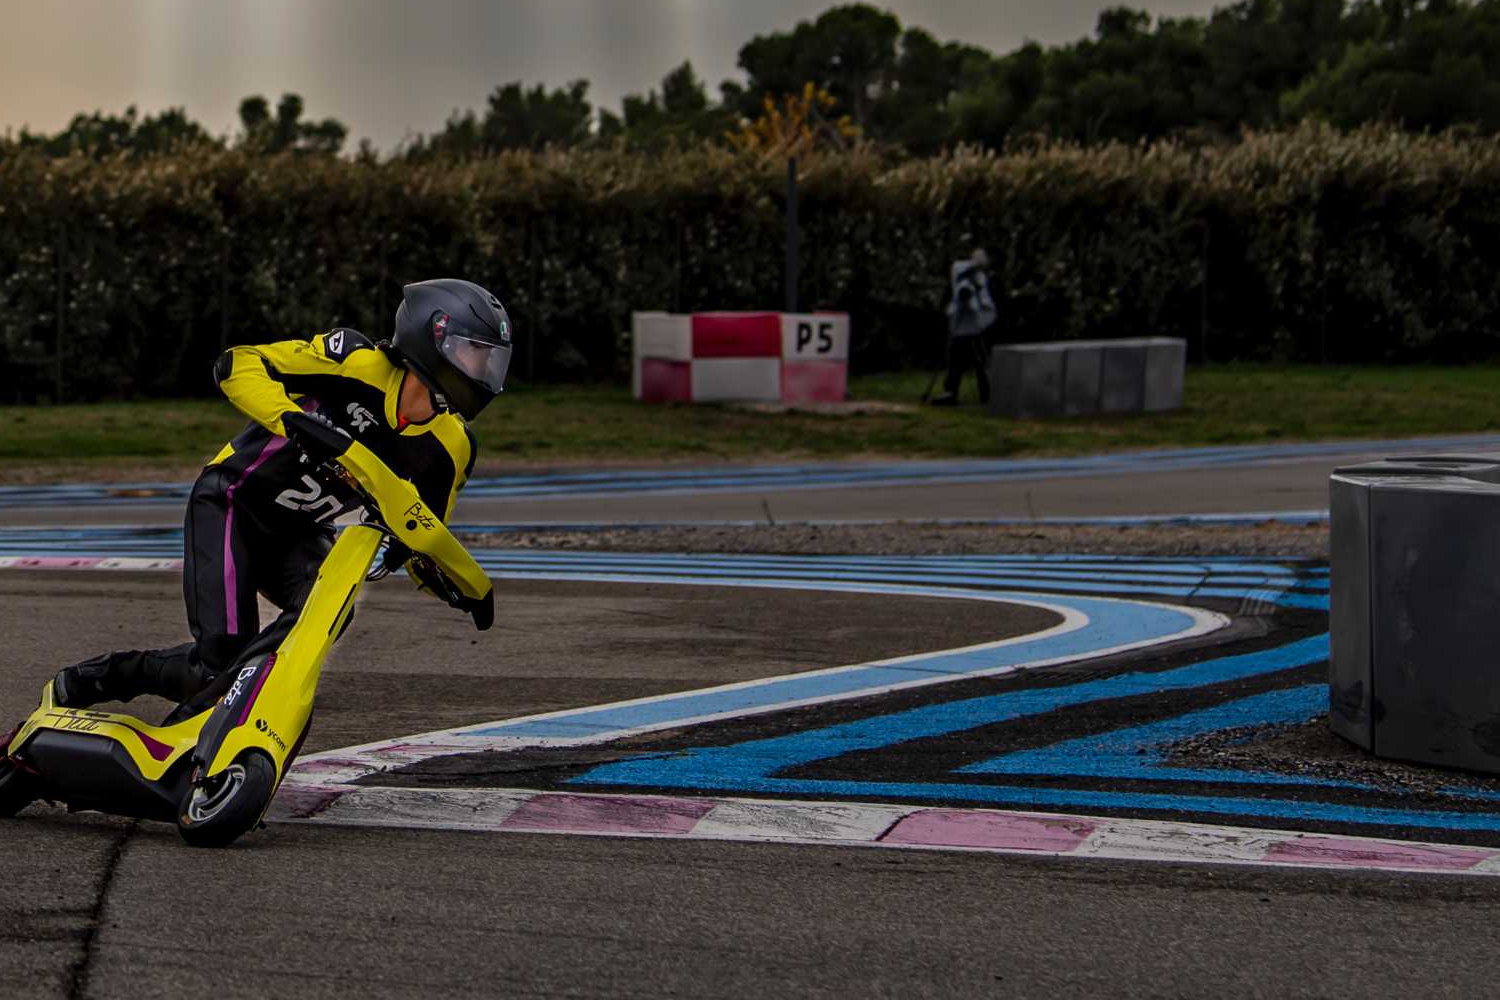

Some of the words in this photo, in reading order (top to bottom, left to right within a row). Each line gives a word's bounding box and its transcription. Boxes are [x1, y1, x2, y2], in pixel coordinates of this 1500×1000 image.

[797, 323, 832, 353] P5
[403, 502, 435, 530] Beta
[224, 666, 257, 706] Beta
[267, 729, 286, 751] ycom
